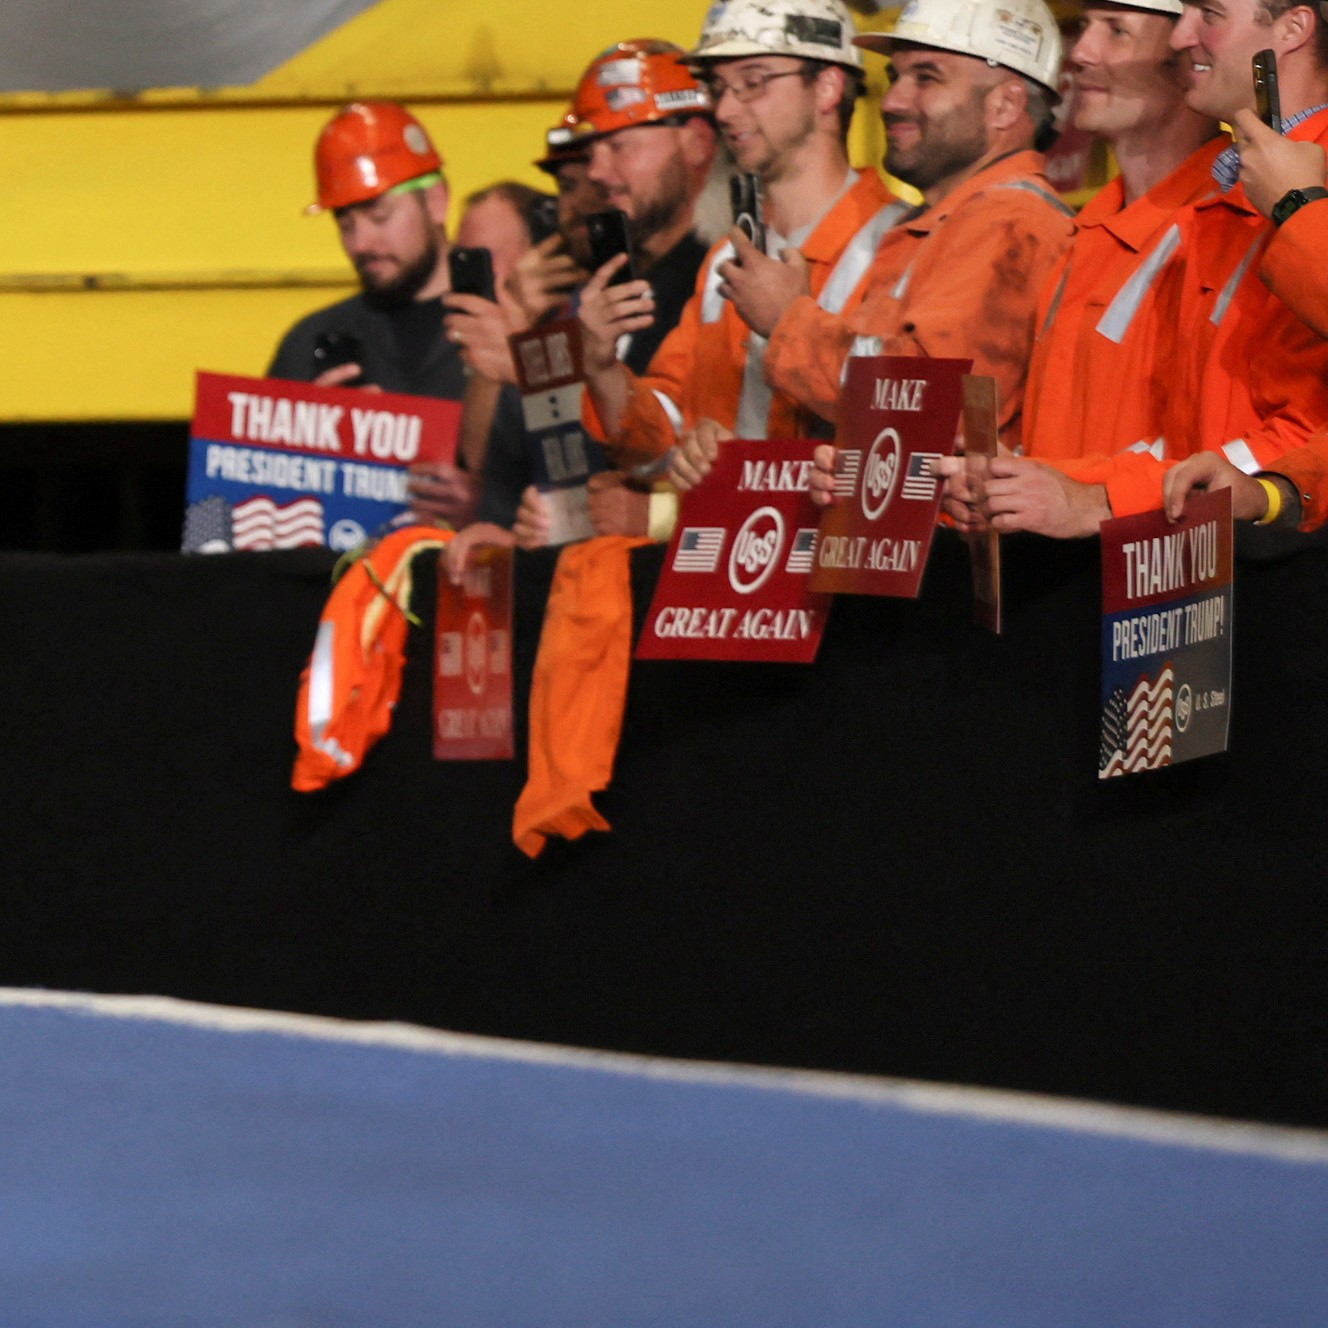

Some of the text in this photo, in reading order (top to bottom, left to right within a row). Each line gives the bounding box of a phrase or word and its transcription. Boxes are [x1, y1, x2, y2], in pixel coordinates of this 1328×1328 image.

[870, 378, 927, 411] MAKE
[227, 391, 422, 462] THANK YOU
[205, 444, 412, 503] PRESIDENT TRUM
[737, 460, 815, 492] MAKE
[819, 536, 922, 572] GREAT AGAIN
[1122, 520, 1217, 600] THANK YOU
[654, 606, 815, 640] GREAT AGAIN
[1112, 595, 1224, 662] PRESIDENT TRUMP!
